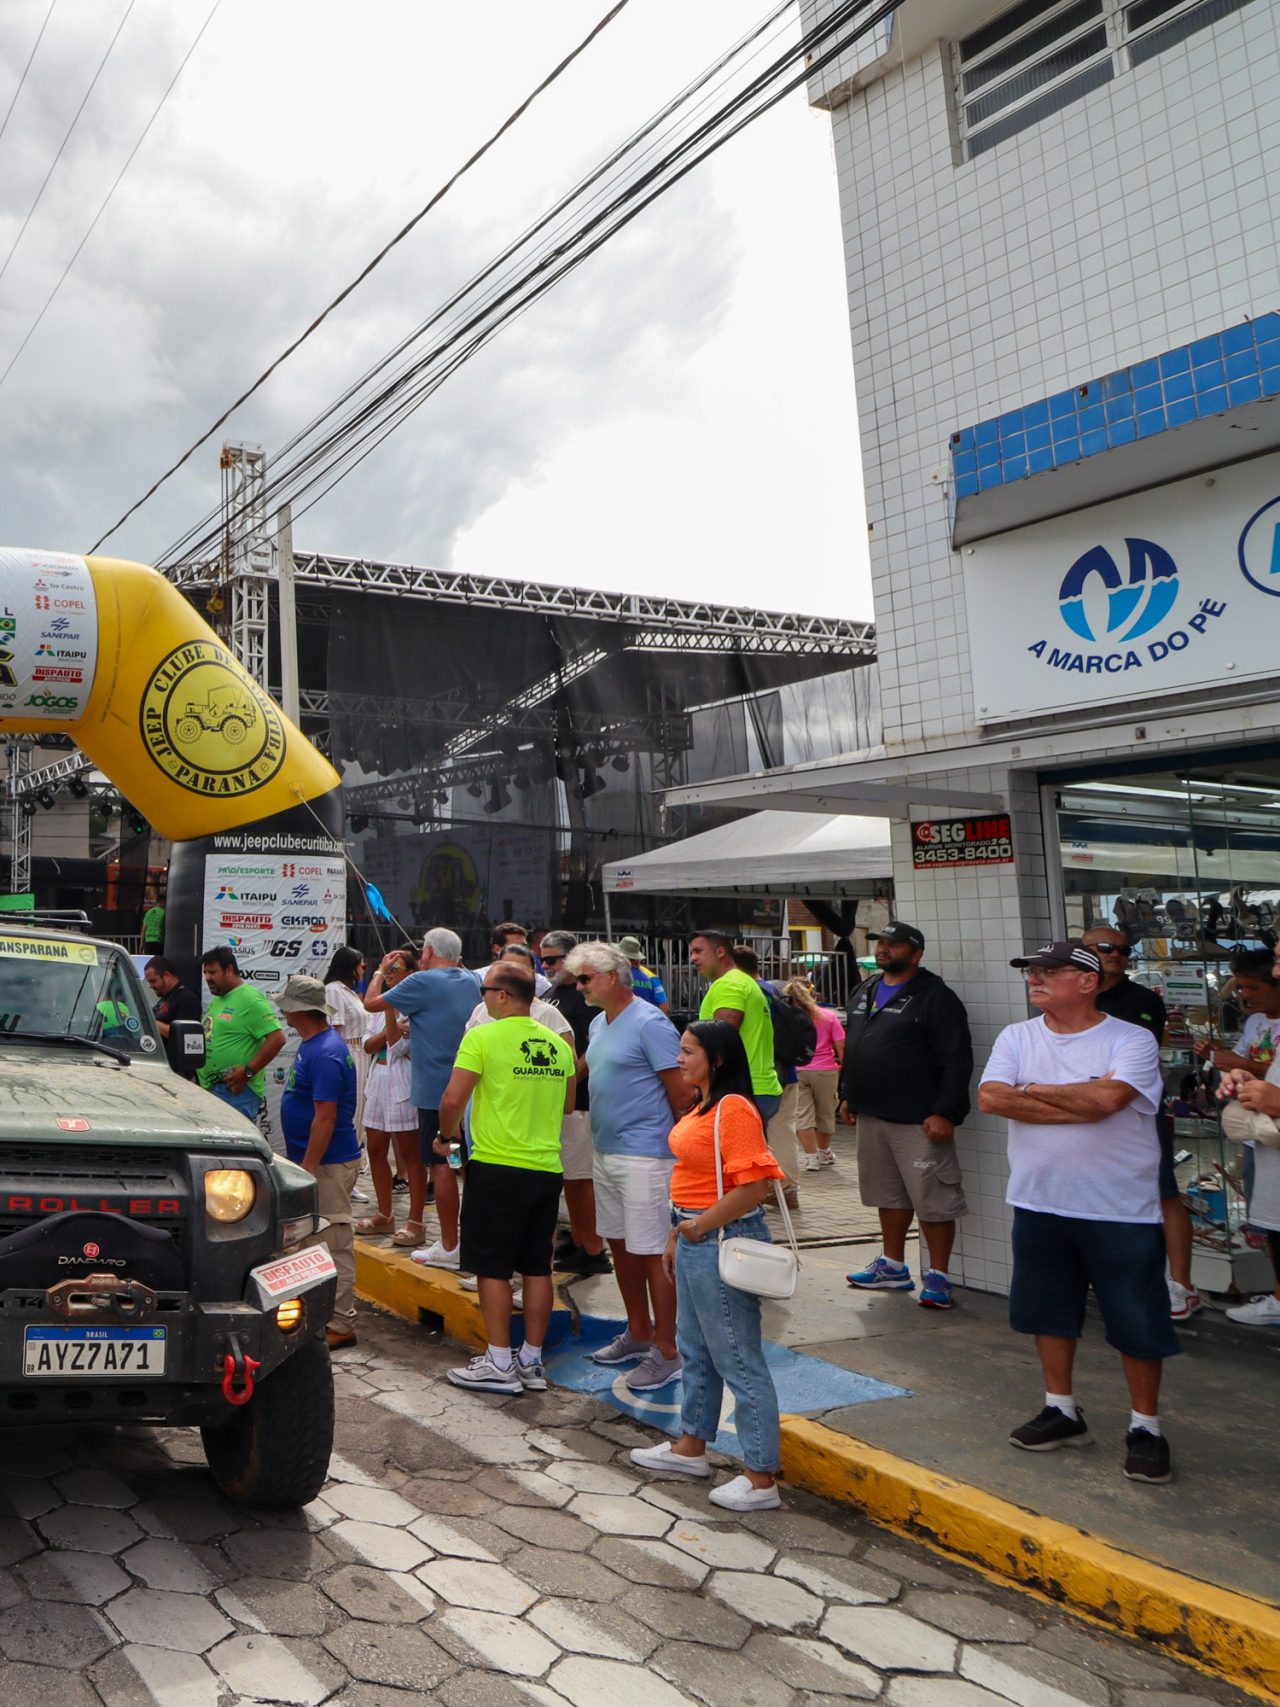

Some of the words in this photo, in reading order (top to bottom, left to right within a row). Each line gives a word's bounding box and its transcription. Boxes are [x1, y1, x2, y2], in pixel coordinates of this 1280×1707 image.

[54, 600, 86, 609] COPEL
[41, 632, 79, 640] SANEPAR
[1028, 639, 1048, 659] A
[1047, 649, 1142, 674] MARCA
[1148, 631, 1189, 662] DO
[1188, 598, 1227, 634] PÉ
[36, 669, 81, 677] DISPAUTO
[154, 645, 205, 693] CLUBE
[24, 695, 77, 708] JOGOS
[147, 708, 172, 757] JEEP
[174, 765, 261, 792] PARANÁ
[945, 840, 990, 848] MONITORADO
[914, 845, 1012, 863] 3453-8400
[299, 867, 323, 875] COPEL
[241, 893, 277, 901] ITAIPU
[222, 915, 271, 923] DISPAUTO
[281, 916, 326, 925] EKRON
[513, 1067, 564, 1076] GUARATUBA
[263, 1253, 325, 1282] DISPAUTO
[37, 1343, 149, 1370] AYZ7A71
[26, 1364, 35, 1373] BR
